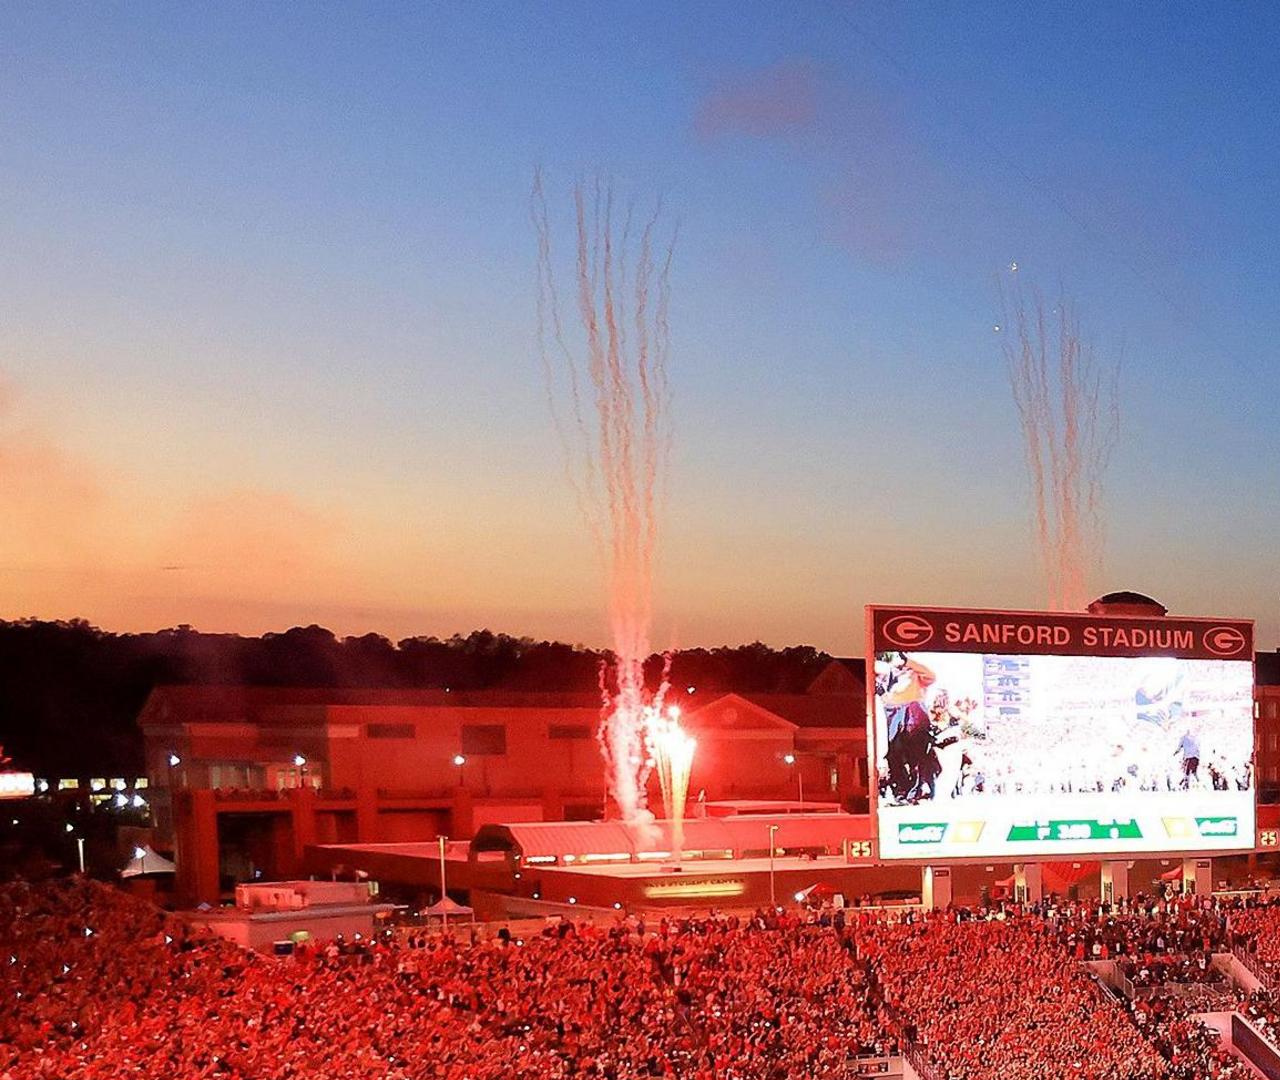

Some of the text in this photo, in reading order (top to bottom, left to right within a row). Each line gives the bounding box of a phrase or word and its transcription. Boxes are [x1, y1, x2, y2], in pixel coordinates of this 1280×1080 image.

[944, 622, 1195, 650] SANFORD STADIUM
[1261, 831, 1277, 846] 25
[851, 840, 872, 857] 25
